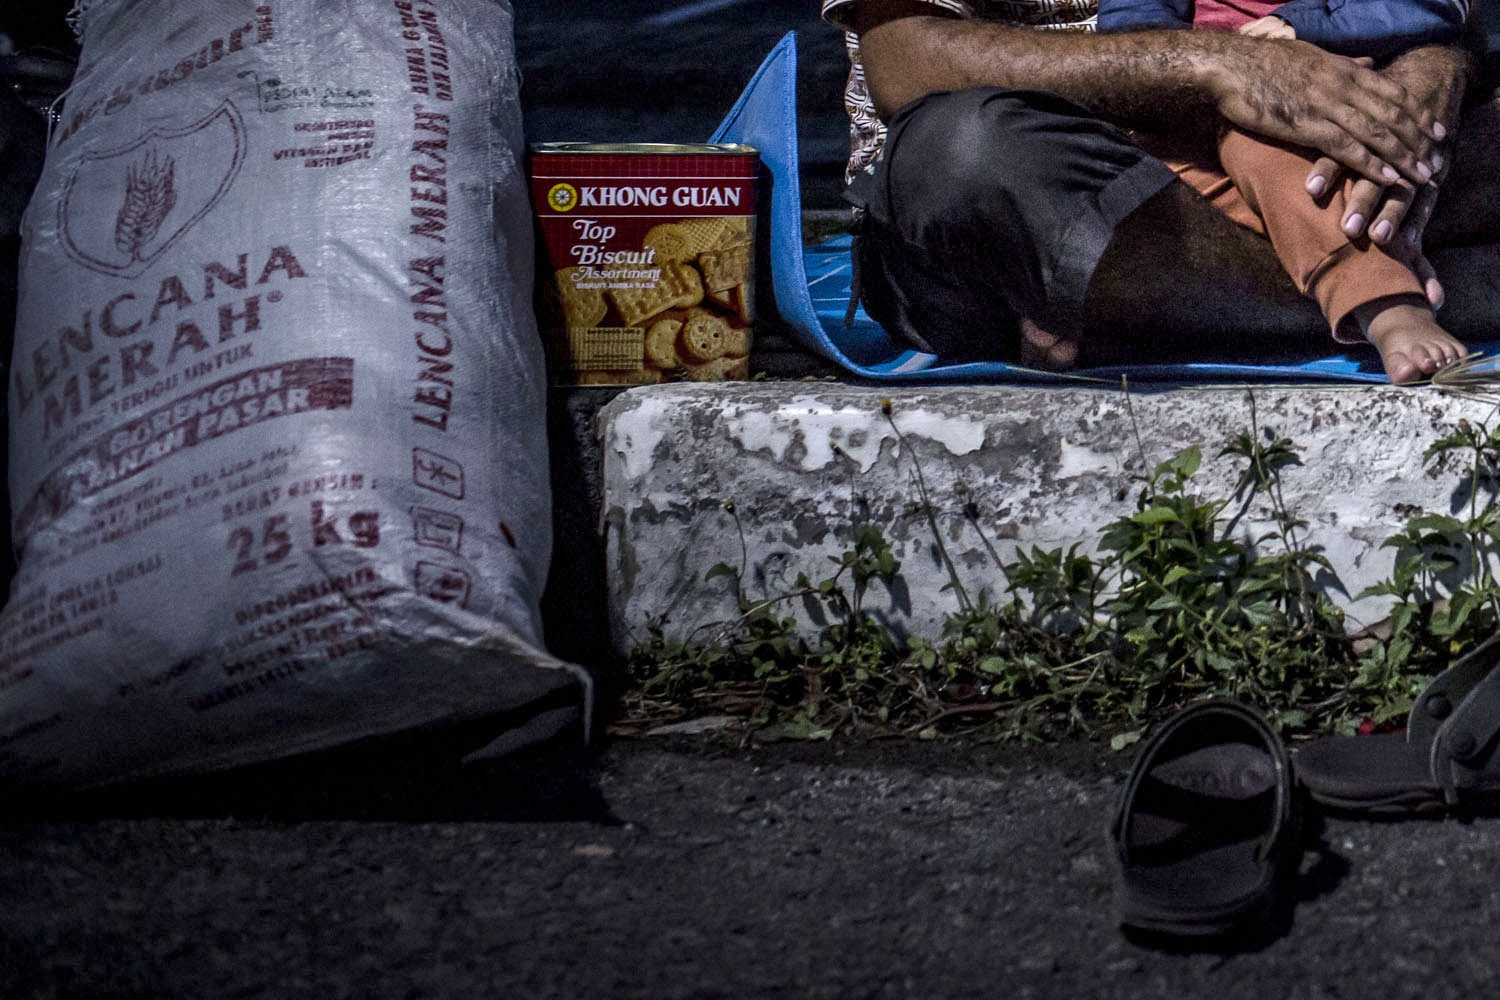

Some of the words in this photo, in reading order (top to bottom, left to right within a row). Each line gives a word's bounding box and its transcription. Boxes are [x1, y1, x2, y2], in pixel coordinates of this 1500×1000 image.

[410, 111, 451, 244] MERAH
[580, 186, 668, 207] KHONG
[673, 186, 742, 207] GUAN
[571, 245, 656, 266] Biscuit
[572, 219, 616, 244] Top
[570, 265, 662, 282] Assortment
[13, 246, 309, 418] LENCANA
[410, 256, 454, 432] LENCANA
[42, 294, 262, 441] MERAH
[199, 387, 309, 436] PASAR
[227, 513, 293, 578] 25
[310, 500, 380, 549] kg
